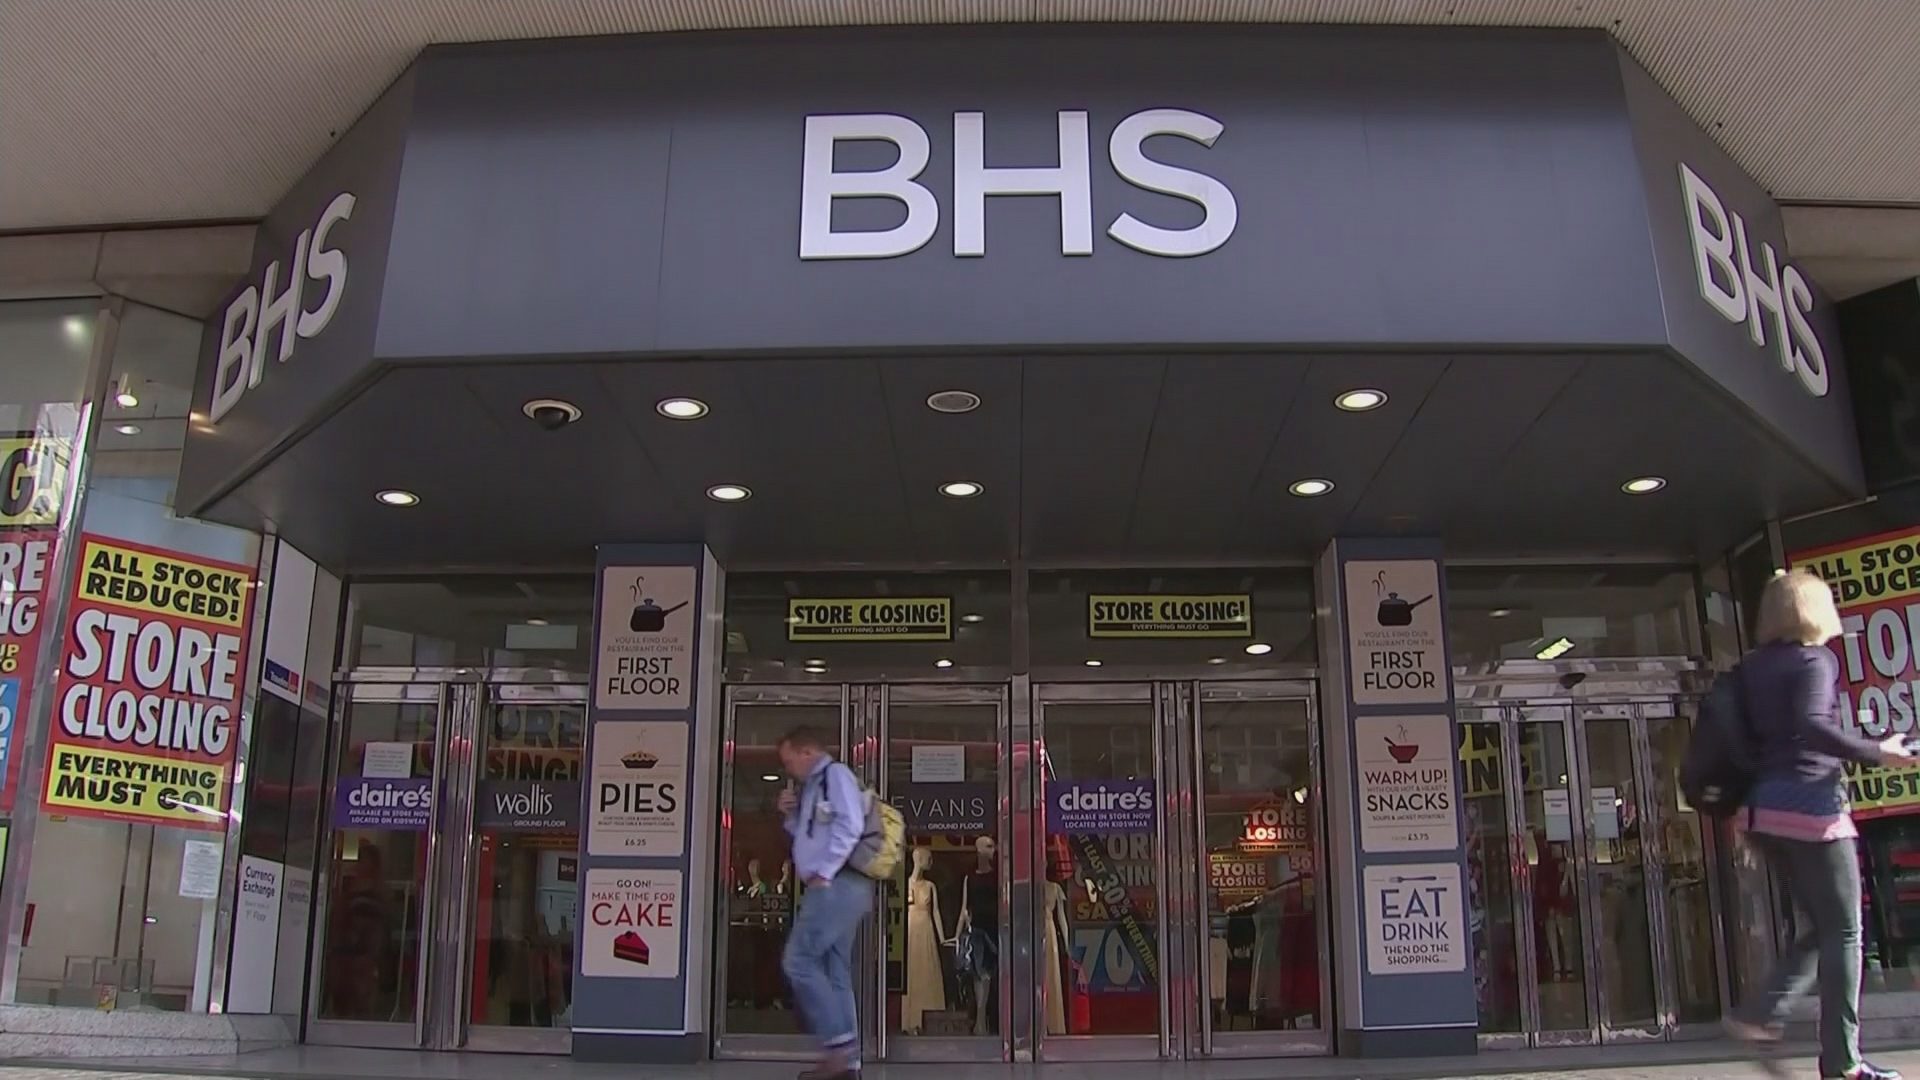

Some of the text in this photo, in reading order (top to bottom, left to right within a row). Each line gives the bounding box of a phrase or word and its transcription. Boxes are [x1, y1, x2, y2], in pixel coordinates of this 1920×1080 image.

[799, 107, 1238, 259] BHS
[1678, 161, 1830, 397] BHS
[209, 192, 357, 424] BHS
[1860, 544, 1920, 572] STO
[90, 550, 241, 597] ALL STOCK
[86, 572, 240, 621] REDUCED!
[794, 604, 945, 624] STORE CLOSING!
[1094, 601, 1245, 621] STORE CLOSING!
[1842, 604, 1920, 683] TO
[68, 608, 241, 700] STORE
[1371, 651, 1424, 669] FIRST
[618, 657, 672, 674] FIRST
[608, 677, 680, 695] FLOOR
[1364, 671, 1435, 690] FLOOR
[62, 683, 230, 755] CLOSING
[1840, 681, 1920, 739] LOSI
[58, 752, 217, 789] EVERYTHING
[1365, 769, 1447, 785] WARM UP!
[55, 775, 215, 812] MUST GO!
[348, 783, 431, 808] claire's
[495, 784, 553, 815] wallis
[600, 783, 676, 813] PIES
[1059, 786, 1153, 811] claire's
[1367, 792, 1449, 812] SNACKS
[891, 795, 984, 817] EVANS
[393, 817, 426, 825] KIDSWEAR
[1061, 813, 1096, 821] AVAILABLE
[1064, 821, 1096, 829] LOCATED
[1243, 809, 1306, 826] TORE
[1241, 827, 1306, 840] LOSING
[245, 866, 275, 884] Currency
[1212, 863, 1265, 876] STORE
[243, 880, 275, 898] Exchange
[616, 879, 651, 888] GO ON!
[1212, 877, 1266, 887] CLOSING
[592, 892, 675, 901] MAKE TIME FOR
[1381, 887, 1447, 919] EAT
[592, 902, 673, 927] CAKE
[1382, 921, 1449, 941] DRINK
[1384, 943, 1449, 955] THEN DO THE
